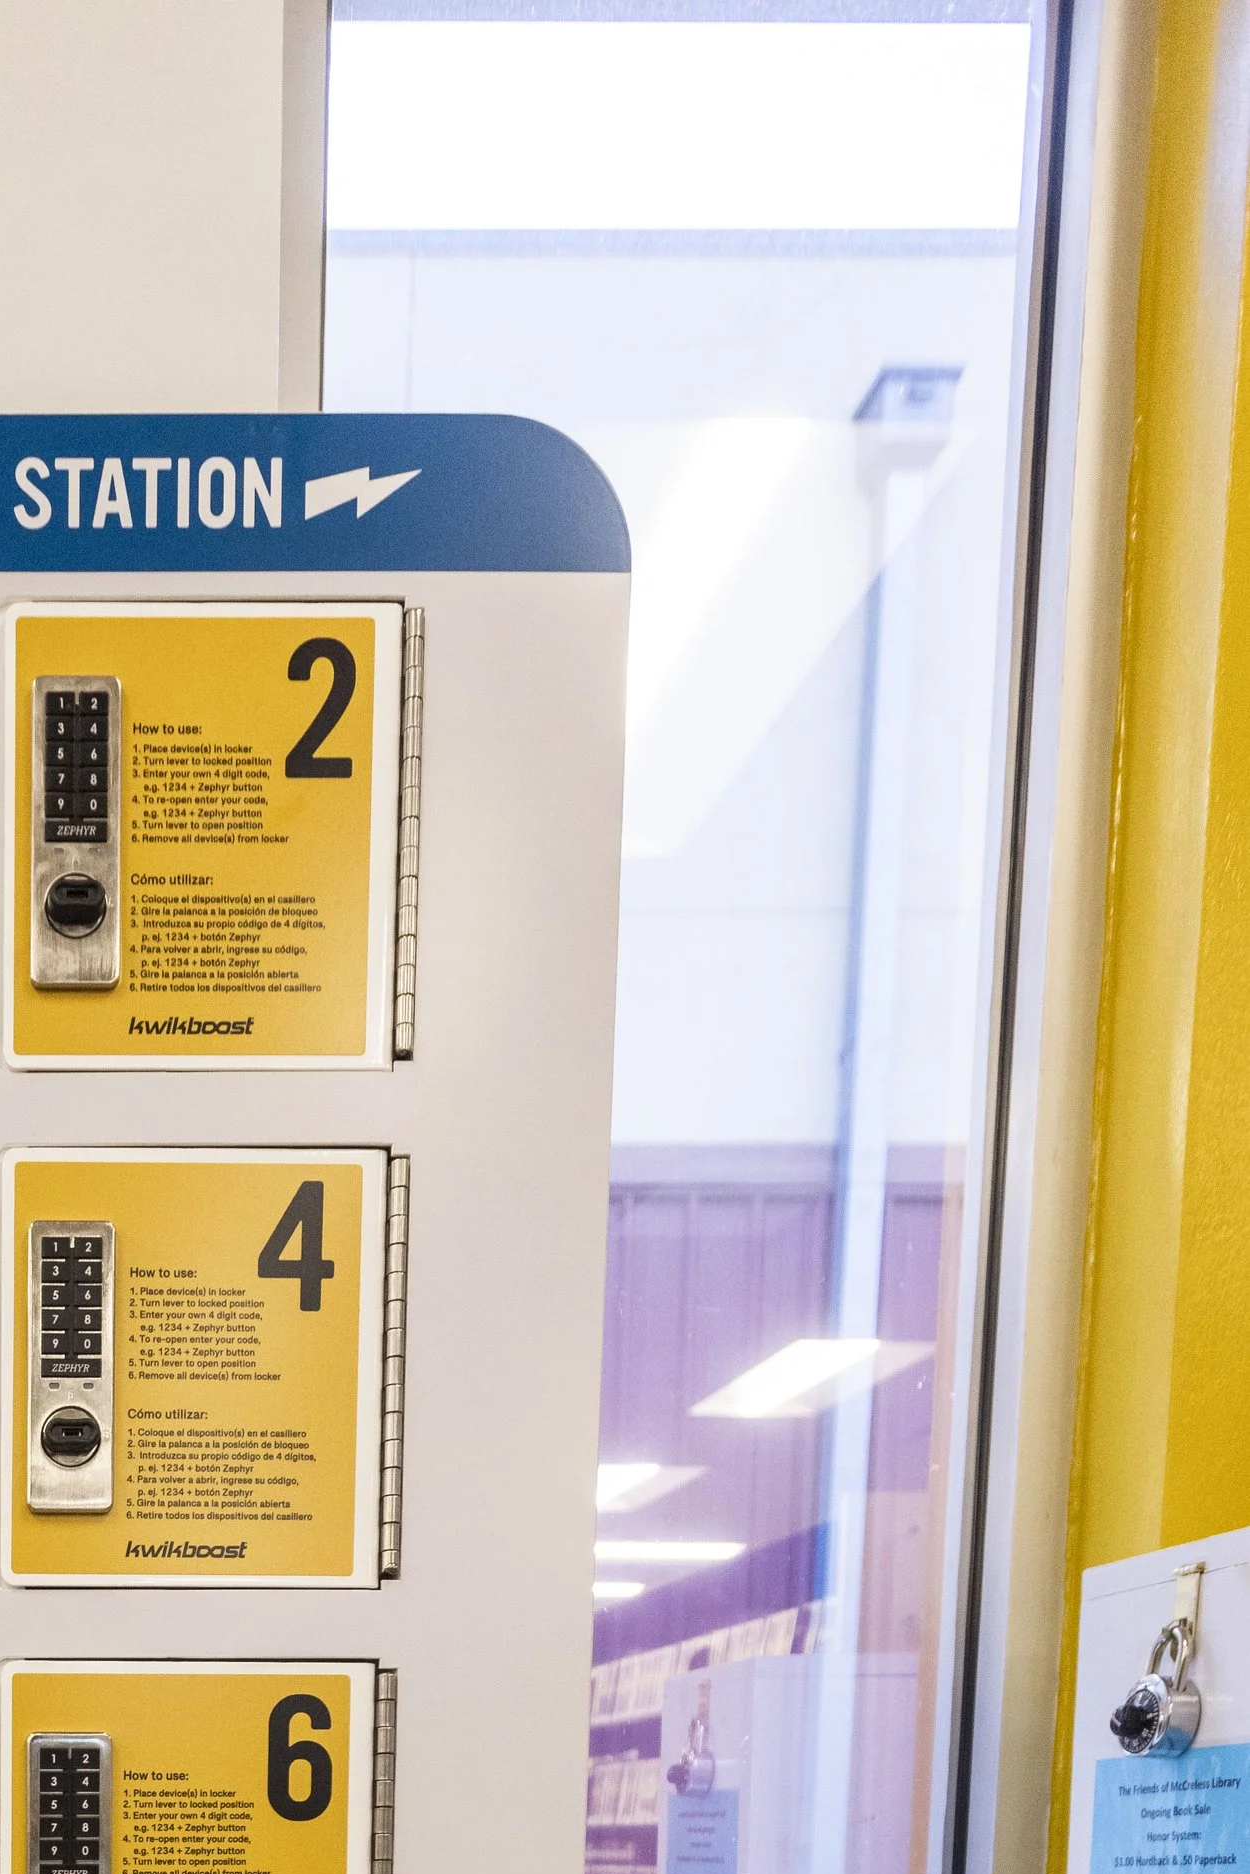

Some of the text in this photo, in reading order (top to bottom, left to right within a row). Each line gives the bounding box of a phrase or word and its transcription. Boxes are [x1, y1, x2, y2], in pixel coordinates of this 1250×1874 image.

[12, 456, 283, 530] STATION
[284, 637, 357, 779] 2
[132, 722, 202, 735] How to use:
[56, 824, 97, 837] ZEPHYR
[130, 873, 214, 886] Cómo utilizar:
[128, 1016, 255, 1035] kwikboost
[257, 1180, 335, 1312] 4
[129, 1266, 197, 1279] How to use:
[139, 1324, 156, 1334] e.g.
[158, 1322, 183, 1332] 1234
[192, 1323, 225, 1334] Zephyr
[226, 1323, 256, 1333] button
[51, 1363, 91, 1373] ZEPHYR
[127, 1408, 208, 1420] Cómo utilizar:
[125, 1540, 248, 1559] kwikboost
[267, 1693, 333, 1822] 6
[123, 1770, 189, 1781] How to use:
[1118, 1777, 1241, 1797] The Friends of McCreless Library
[1141, 1804, 1211, 1820] Ongoing Book Sale
[1147, 1830, 1202, 1844] Honor System:
[1114, 1853, 1237, 1867] $1.00 Hardback & .50 Paperback
